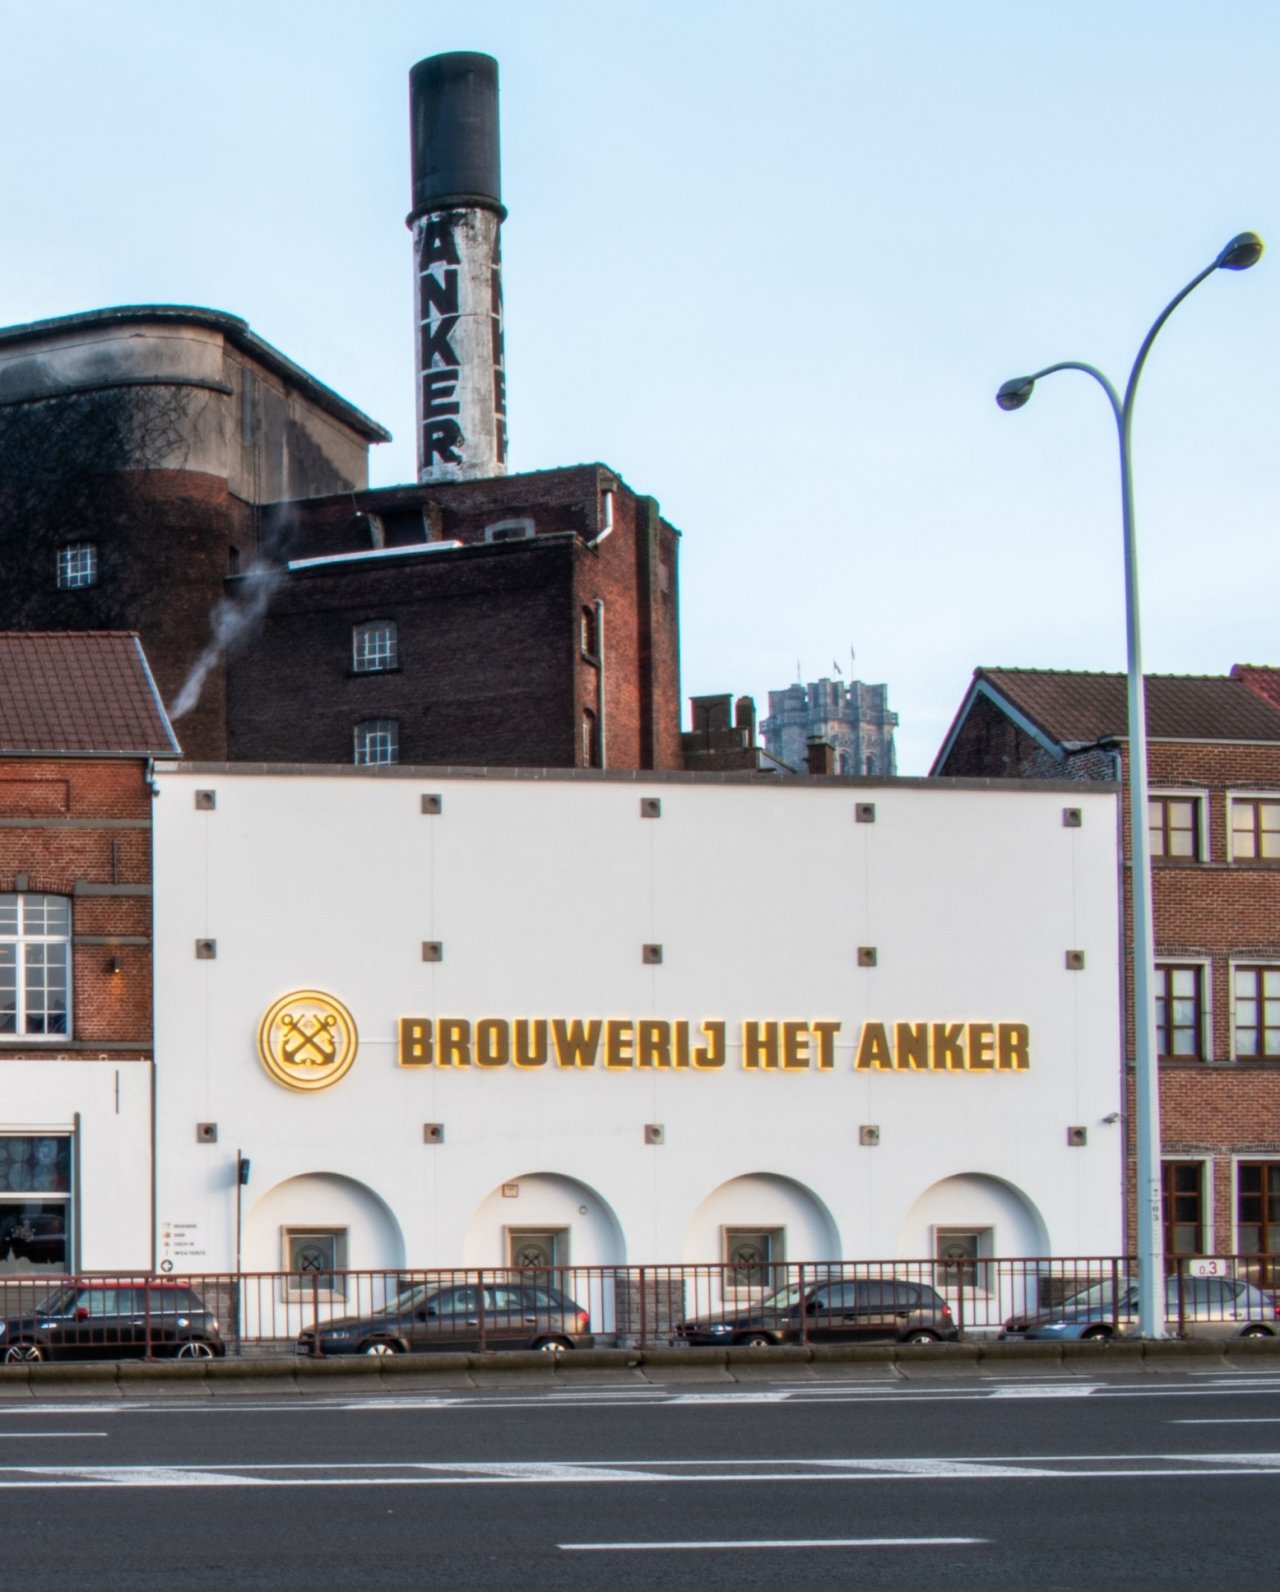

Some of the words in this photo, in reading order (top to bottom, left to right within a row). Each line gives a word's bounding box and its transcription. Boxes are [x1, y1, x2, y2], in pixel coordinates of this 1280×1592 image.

[420, 220, 464, 467] ANKER
[398, 1017, 726, 1069] BROUWERIJ
[742, 1020, 842, 1070] HET
[854, 1022, 1030, 1071] ANKER
[1199, 1261, 1217, 1275] 0.3
